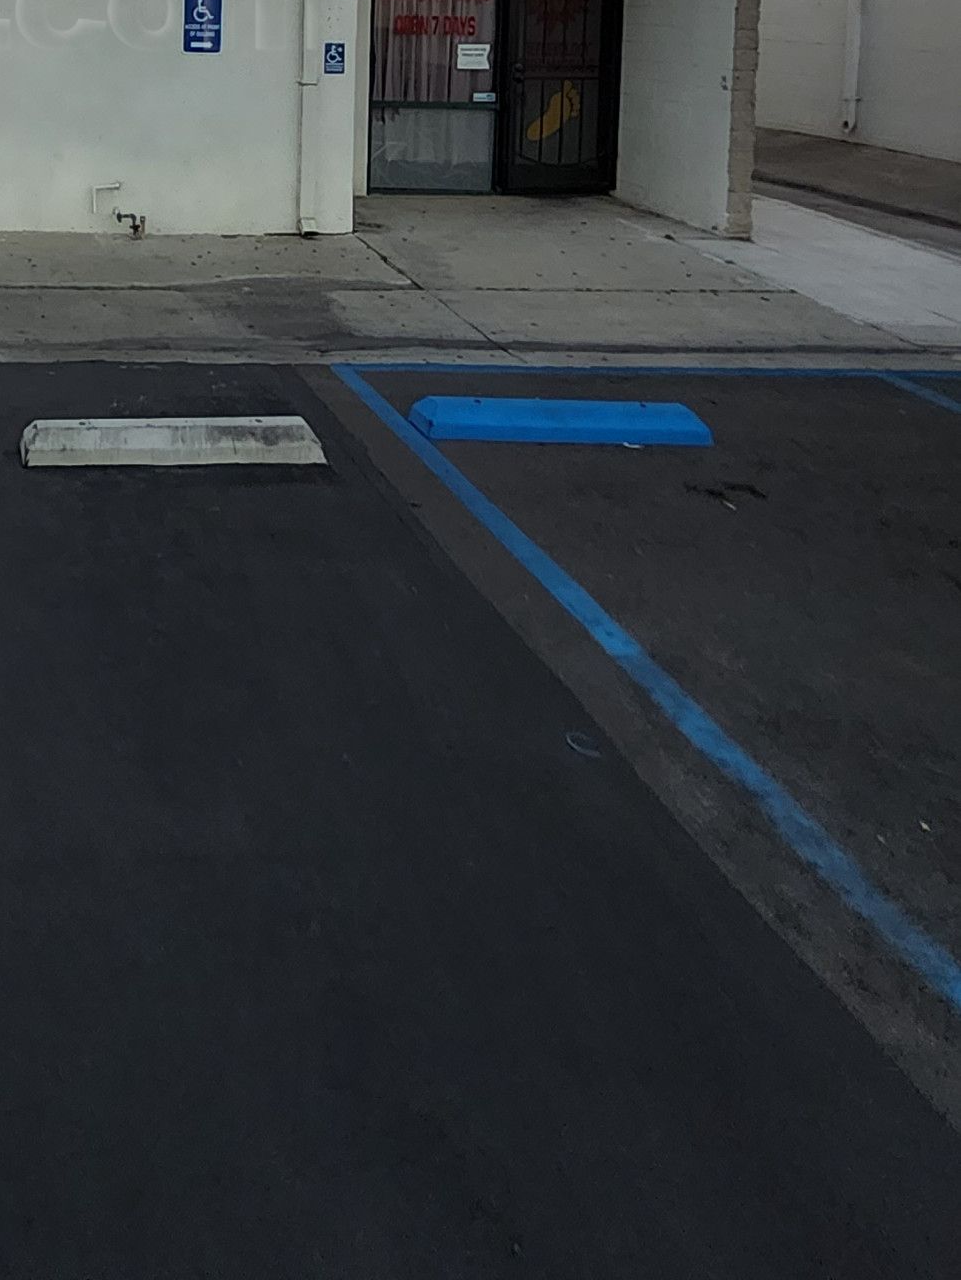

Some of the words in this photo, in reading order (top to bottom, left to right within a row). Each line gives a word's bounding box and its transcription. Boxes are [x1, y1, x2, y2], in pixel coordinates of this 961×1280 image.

[393, 16, 429, 35] OPEN
[431, 16, 439, 35] 7
[443, 16, 476, 35] DAYS
